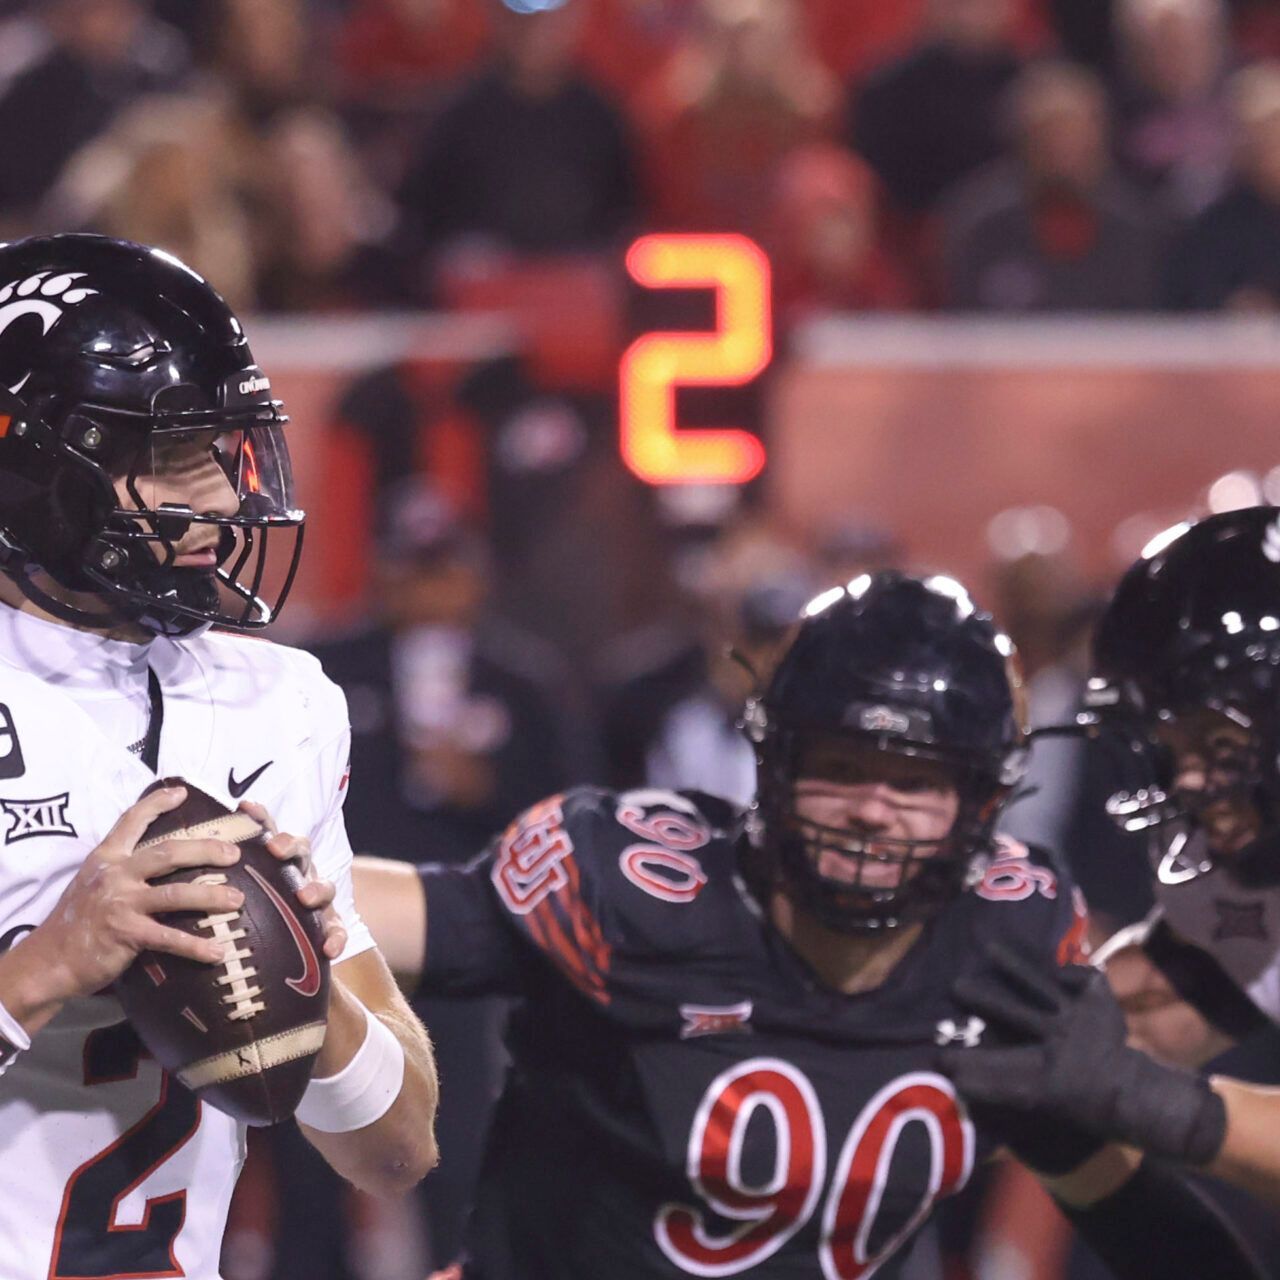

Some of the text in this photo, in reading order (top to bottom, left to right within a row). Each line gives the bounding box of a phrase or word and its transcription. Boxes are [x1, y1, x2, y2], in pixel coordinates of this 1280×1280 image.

[620, 232, 773, 485] 2
[1, 794, 76, 842] XII
[616, 788, 711, 904] 90
